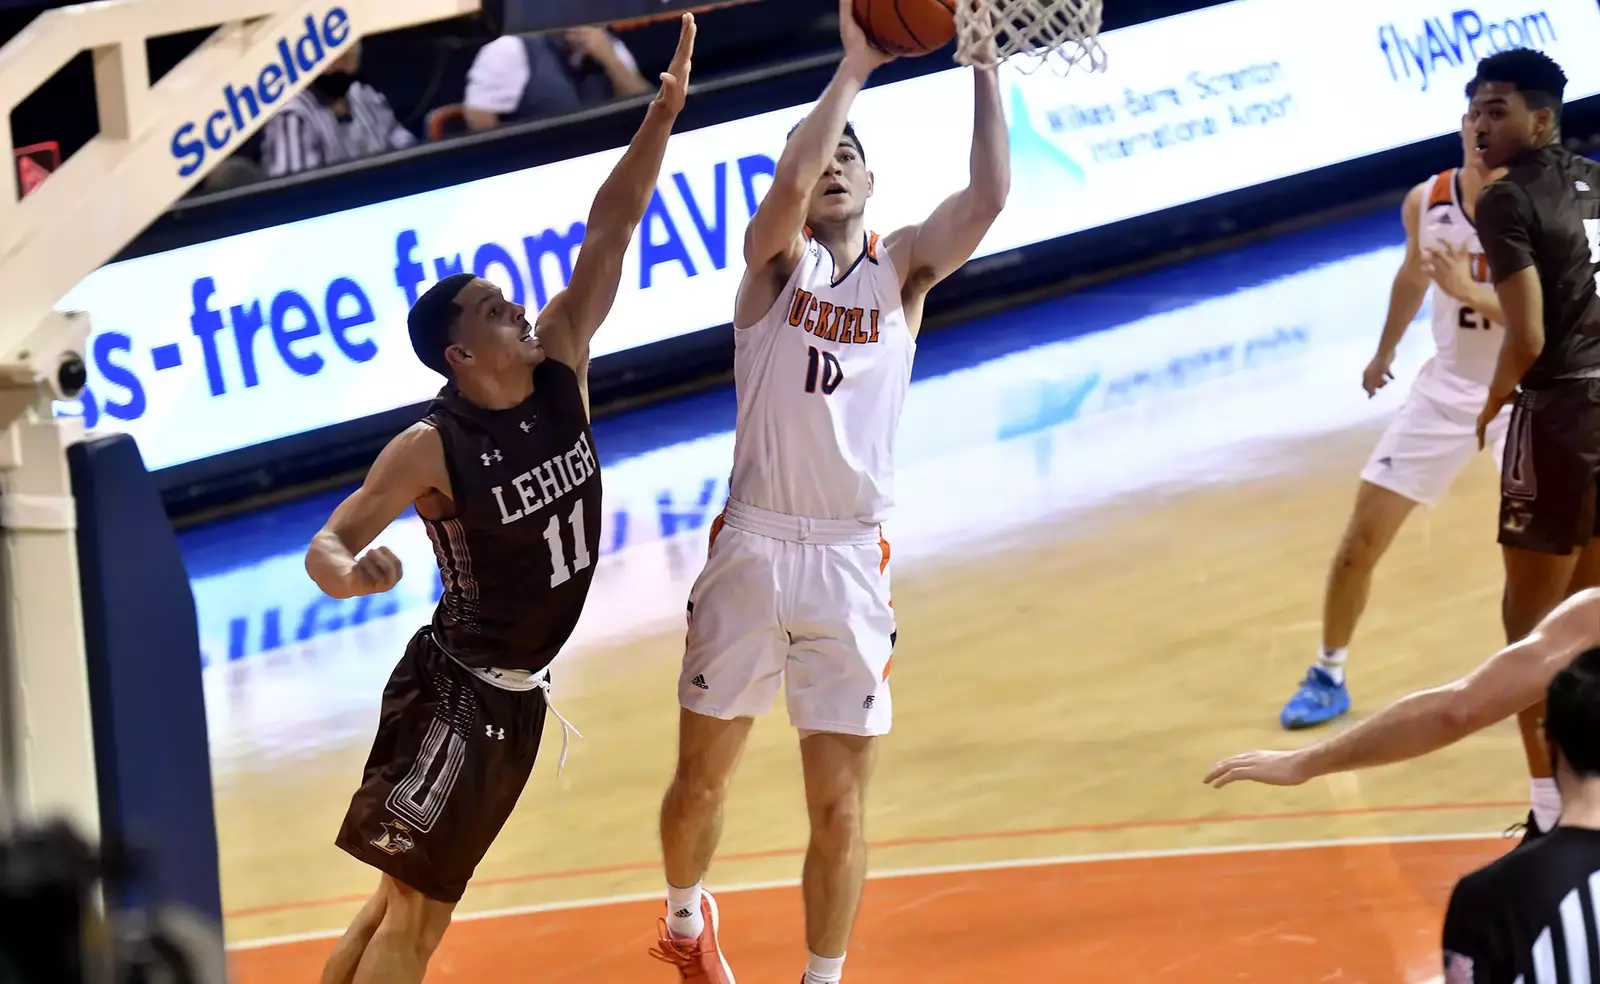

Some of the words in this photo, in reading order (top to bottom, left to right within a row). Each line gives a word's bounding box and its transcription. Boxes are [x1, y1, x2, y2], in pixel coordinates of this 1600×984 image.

[171, 7, 350, 177] Schelde
[394, 228, 588, 312] fom
[787, 288, 880, 344] UCKNELL
[804, 345, 844, 395] 10
[491, 431, 596, 525] LEHIGH
[543, 498, 590, 589] 11
